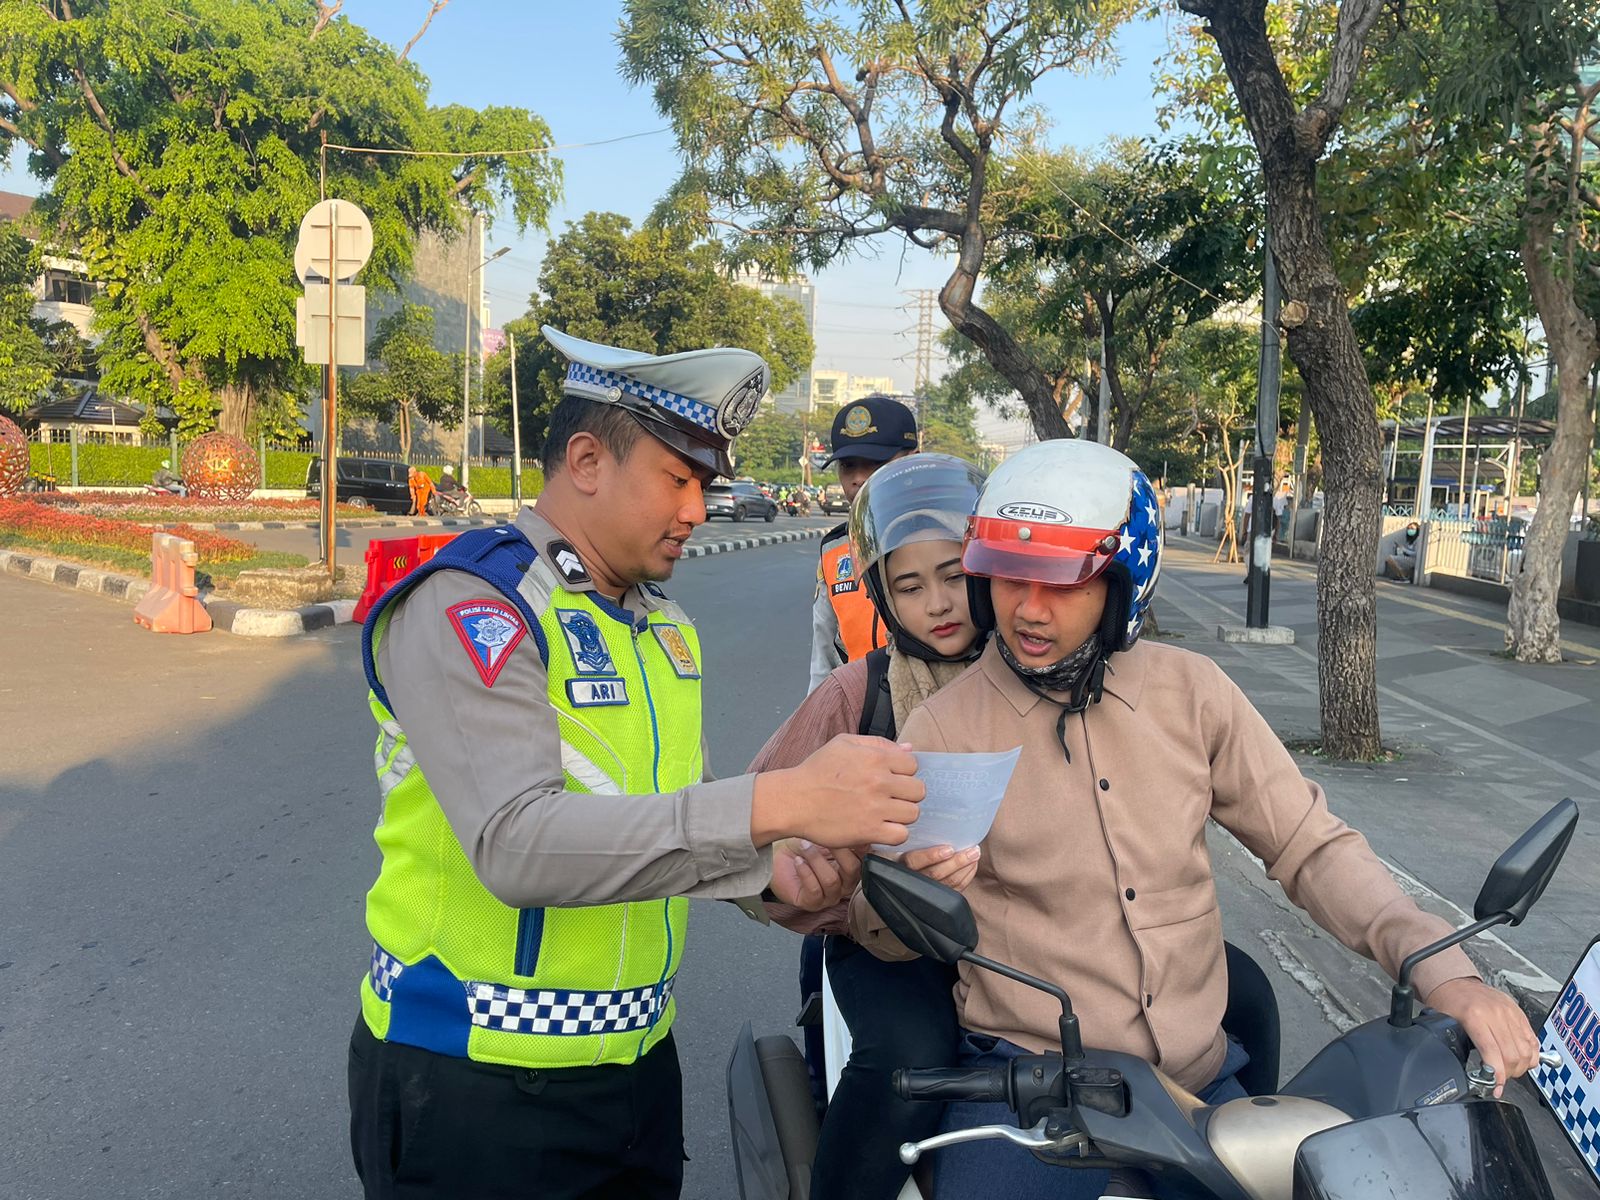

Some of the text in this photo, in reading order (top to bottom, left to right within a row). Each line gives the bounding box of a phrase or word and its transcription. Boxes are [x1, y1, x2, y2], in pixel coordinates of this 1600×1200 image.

[1007, 506, 1058, 520] ZEUS
[834, 581, 853, 593] BENI
[460, 606, 519, 626] POLISI LALU LINTAS
[591, 683, 616, 700] ARI
[1565, 1036, 1596, 1082] LINTAS
